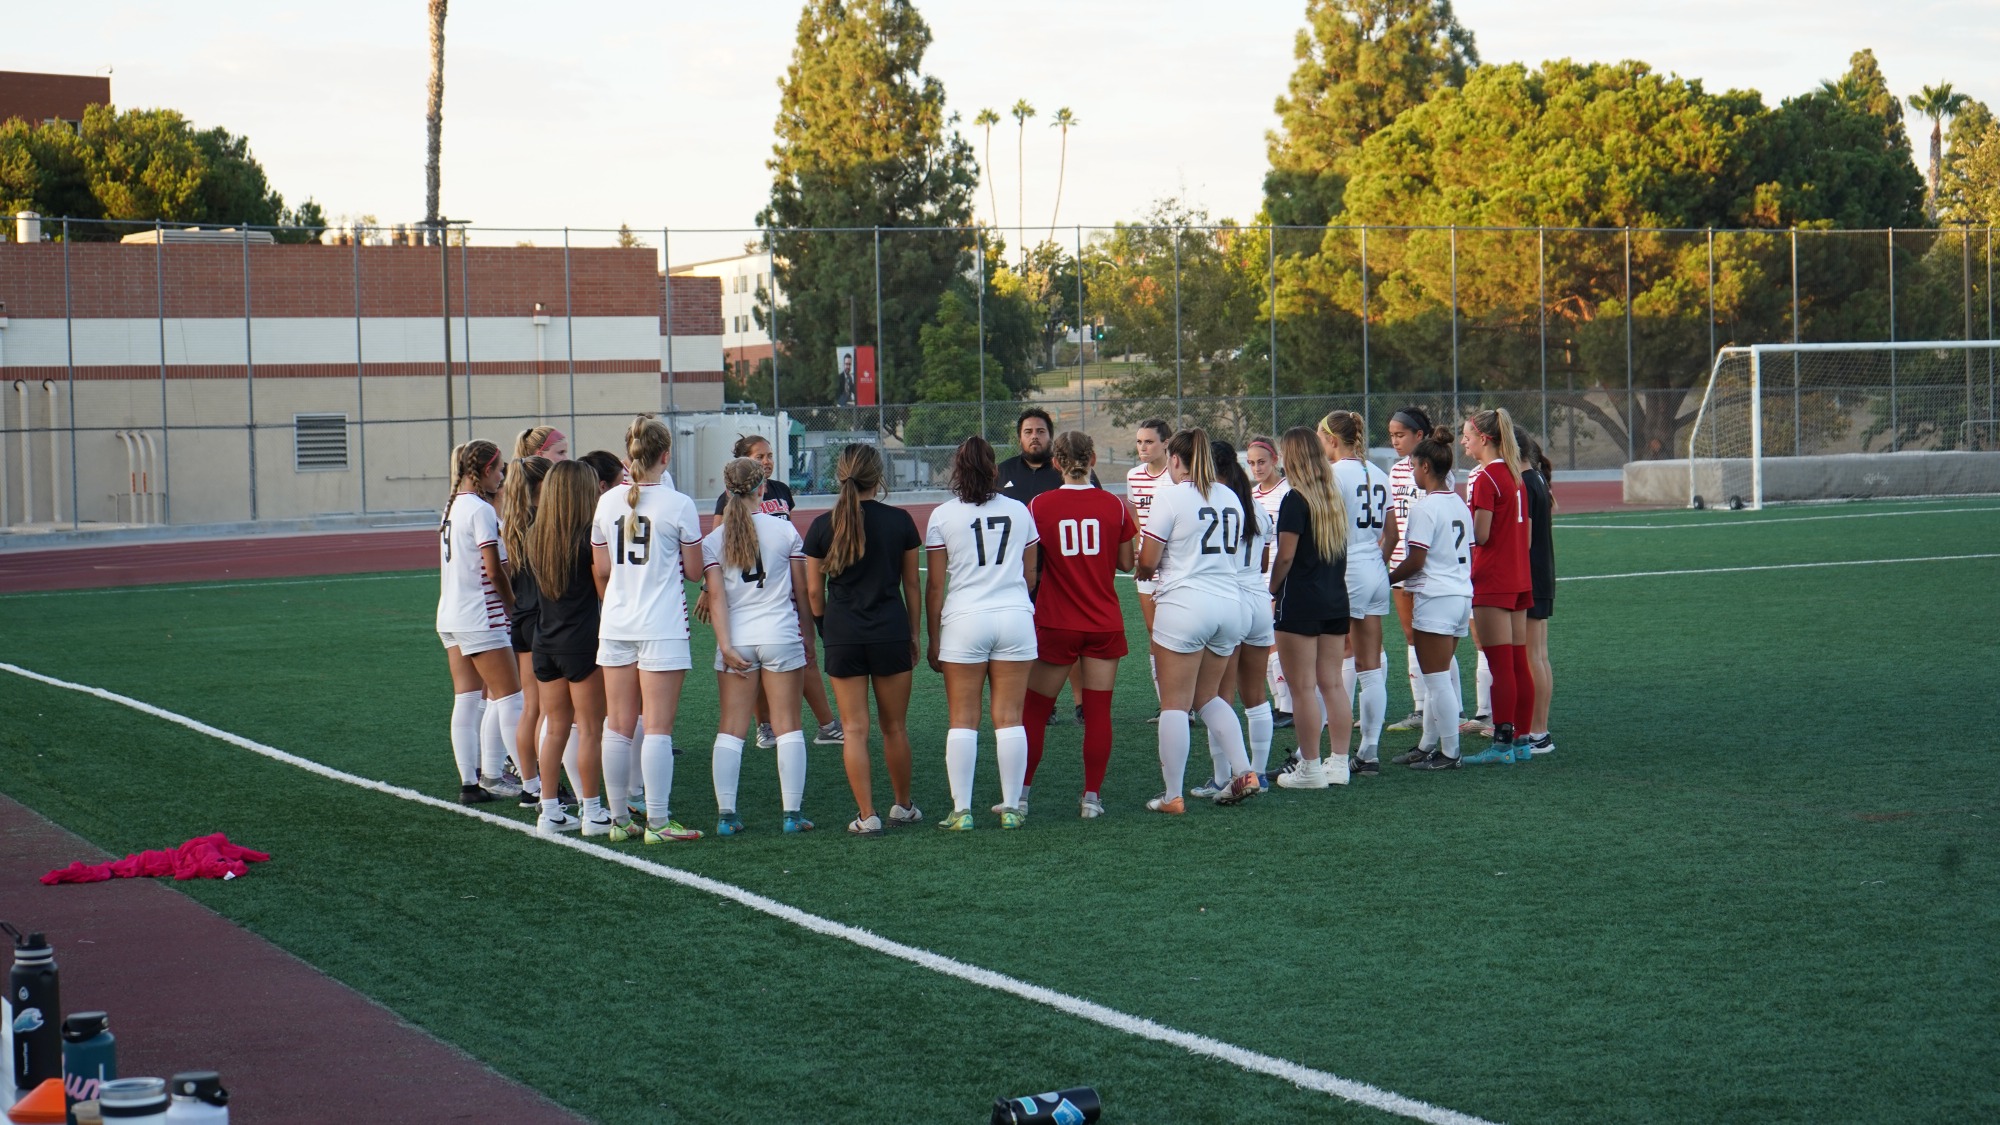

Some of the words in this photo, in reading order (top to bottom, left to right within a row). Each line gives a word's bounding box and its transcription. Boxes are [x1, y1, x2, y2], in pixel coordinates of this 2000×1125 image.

[1356, 484, 1387, 529] 33
[1399, 499, 1409, 518] 16
[1516, 489, 1523, 523] 1
[614, 514, 651, 566] 19
[970, 516, 1012, 567] 17
[1058, 518, 1100, 557] 00
[1198, 506, 1240, 555] 20
[1451, 520, 1467, 565] 2
[741, 549, 767, 589] 4
